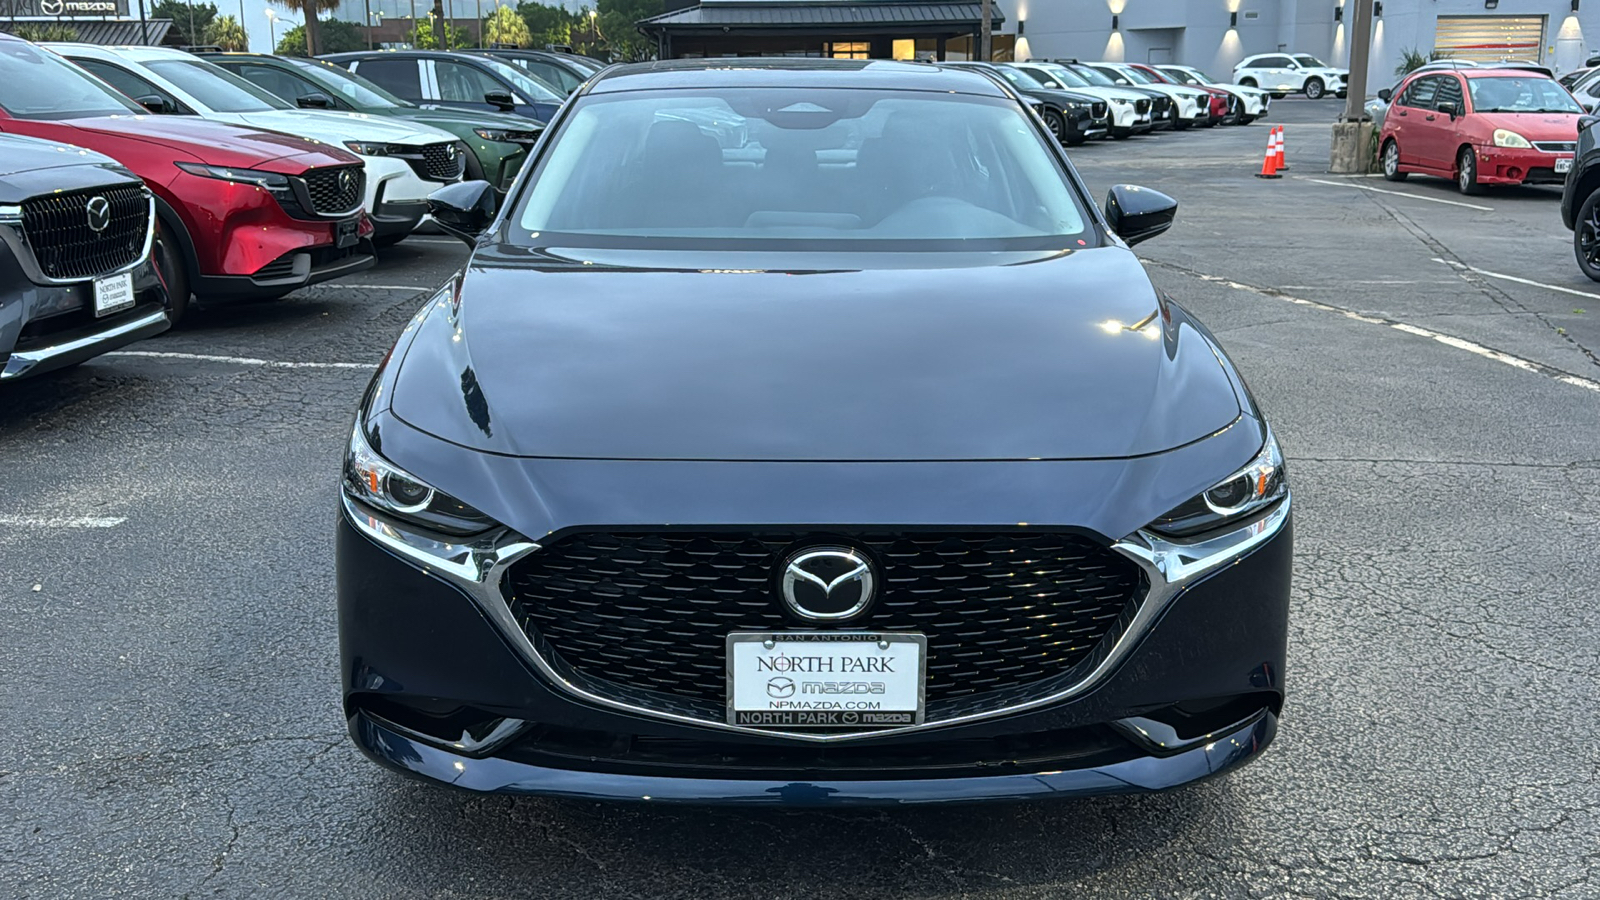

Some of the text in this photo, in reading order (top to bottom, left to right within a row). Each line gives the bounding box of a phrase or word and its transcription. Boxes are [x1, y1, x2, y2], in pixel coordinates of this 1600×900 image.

[66, 1, 115, 11] mazda
[756, 653, 895, 674] NORTH PARK
[801, 681, 885, 694] mazda
[769, 701, 881, 710] NPMAZDA.COM
[740, 712, 912, 724] NORTH PARK mazda
